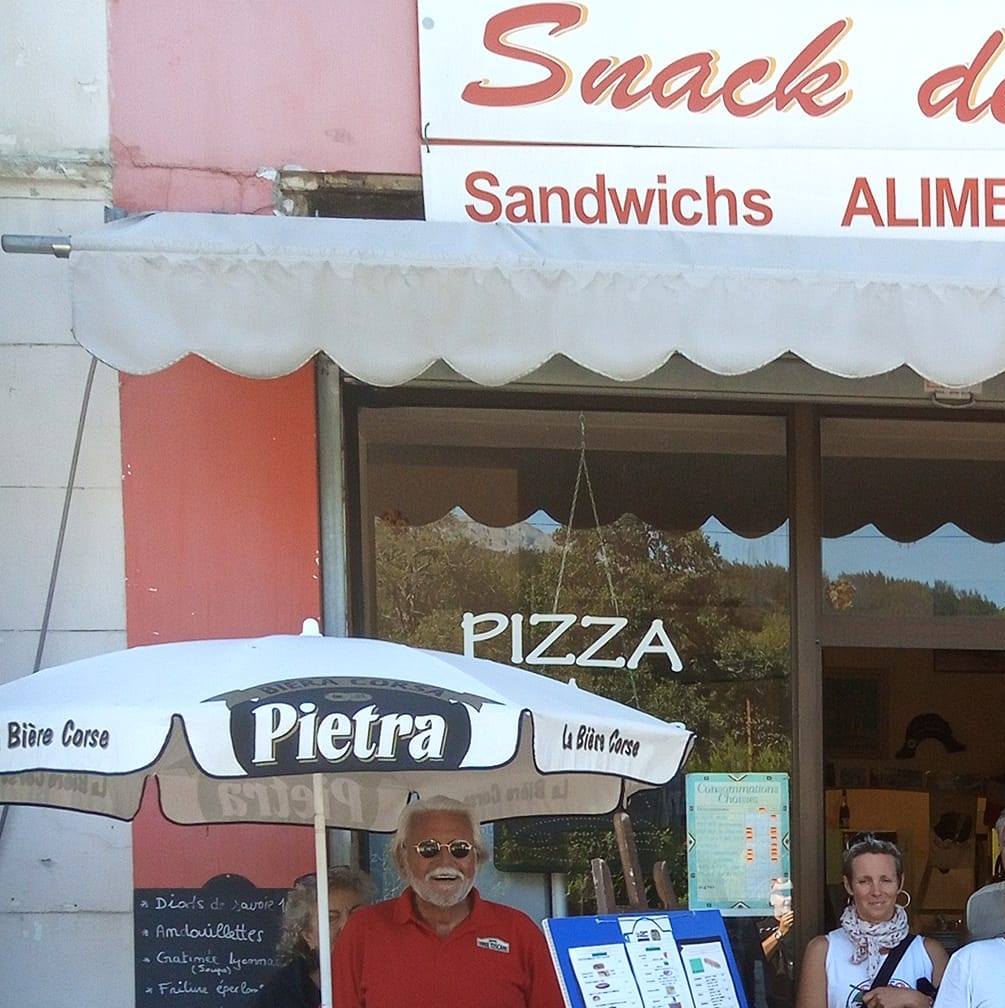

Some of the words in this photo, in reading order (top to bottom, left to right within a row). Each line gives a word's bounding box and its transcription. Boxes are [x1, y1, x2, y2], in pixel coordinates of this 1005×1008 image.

[461, 1, 854, 119] Snack
[464, 170, 774, 226] Sandwichs
[461, 611, 684, 672] PIZZA
[7, 721, 54, 750] Bière
[61, 719, 111, 751] Corse
[251, 702, 449, 768] Pietra
[607, 728, 641, 758] Corse
